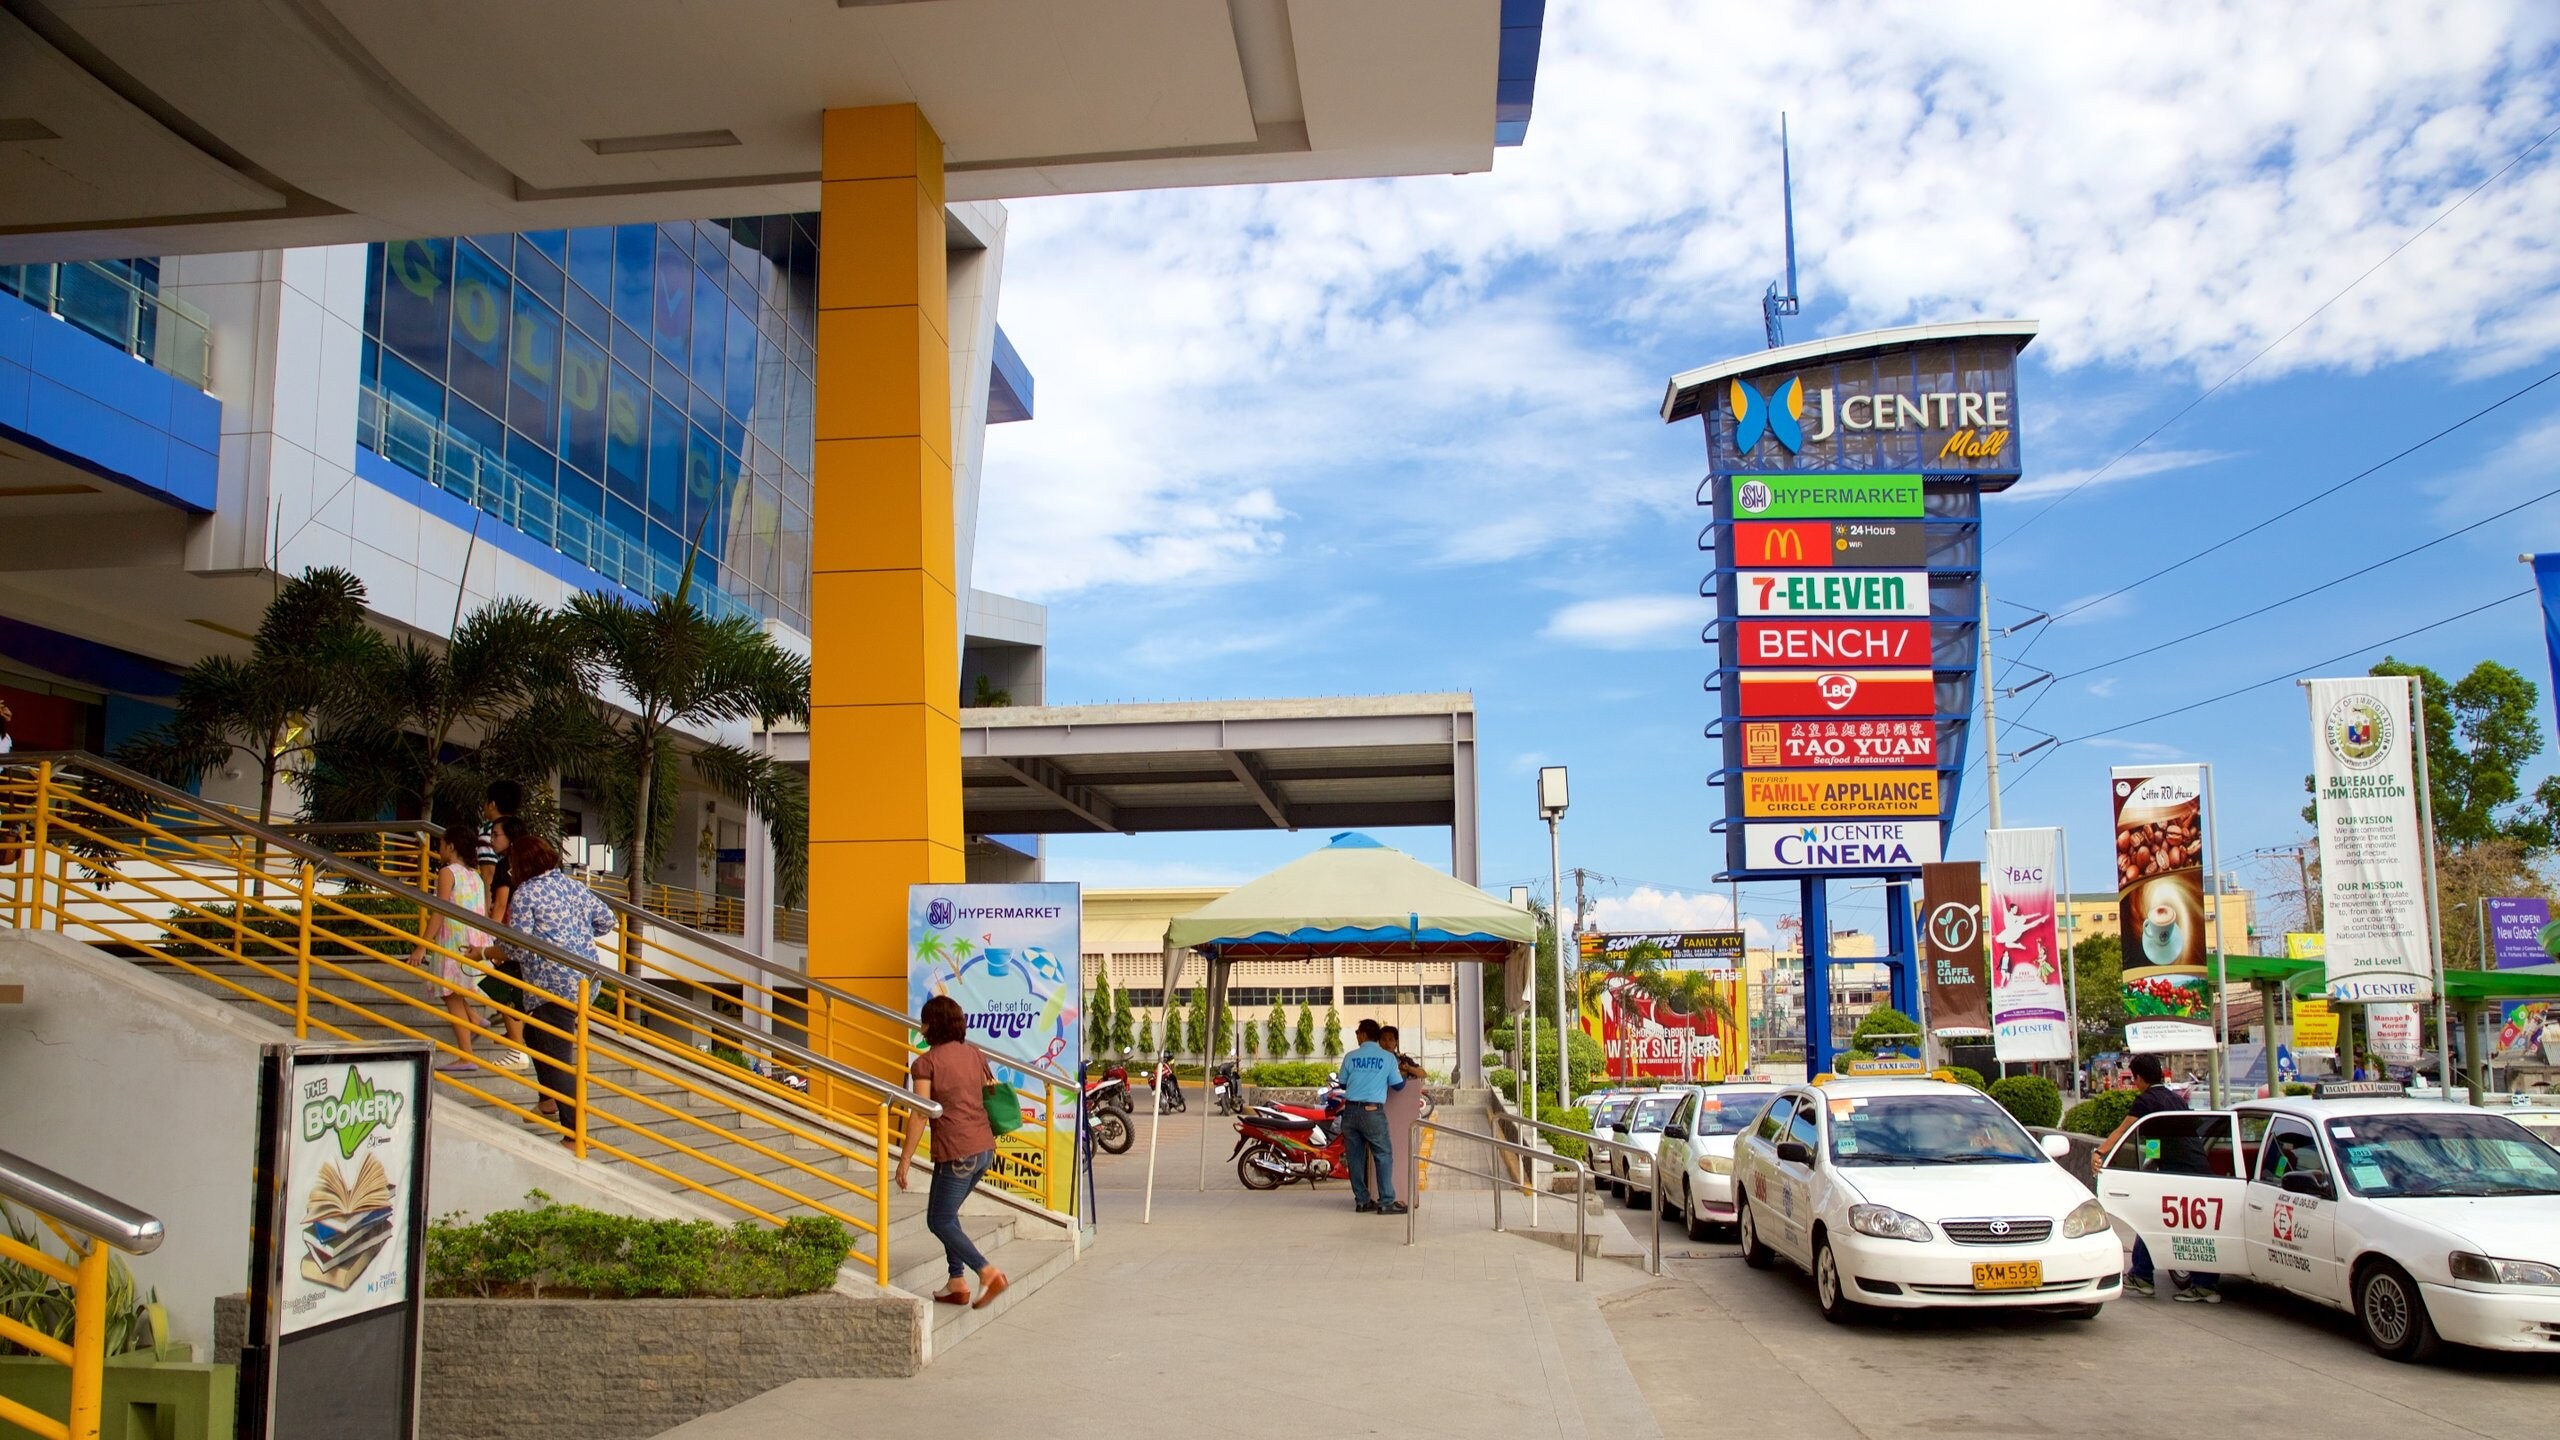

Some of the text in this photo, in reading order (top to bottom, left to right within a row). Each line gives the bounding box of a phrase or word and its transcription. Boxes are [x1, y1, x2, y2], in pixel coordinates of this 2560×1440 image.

[1939, 429, 2009, 458] Mall
[1773, 488, 1919, 504] HYPERMARKET
[1850, 525, 1896, 536] 24 Hours
[1822, 684, 1852, 698] LBC
[1785, 739, 1846, 756] TAO
[1853, 738, 1931, 756] YUAN
[1813, 755, 1904, 766] Seafood Restaurant
[2330, 774, 2394, 787] BUREAU OF
[1751, 782, 1932, 802] FAMILY APPLIANCE
[2322, 785, 2405, 800] IMMIGRATION
[1767, 802, 1918, 811] CIRCLE CORPORATION
[2337, 815, 2393, 825] OUR VISION
[1774, 835, 1913, 865] CINEMA
[2337, 881, 2403, 891] OUR MISSION
[2333, 892, 2341, 900] To
[2342, 892, 2367, 900] control
[2341, 900, 2379, 908] movement
[2388, 898, 2414, 907] persons
[958, 907, 1062, 919] HYPERMARKET
[2350, 907, 2368, 915] from
[2501, 914, 2541, 924] NOW OPEN!
[2336, 931, 2366, 940] National
[2497, 926, 2533, 940] New Globe
[1683, 938, 1718, 948] FAMILY
[1721, 936, 1741, 946] KTV
[1936, 959, 1951, 969] DE
[2354, 956, 2402, 967] 2nd Level
[1937, 967, 1969, 976] CAFFE
[1938, 975, 1975, 985] LUWAK
[988, 999, 1033, 1013] Get set for
[2373, 1014, 2402, 1023] Manage
[963, 1011, 1041, 1039] ummer
[2381, 1022, 2408, 1030] Korean
[2377, 1030, 2412, 1038] Designers
[1607, 1039, 1722, 1059] WEAR SNEAKERS
[1352, 1057, 1384, 1070] TRAFFIC
[1878, 1062, 1898, 1070] TAXI
[304, 1078, 328, 1099] THE
[2324, 1084, 2348, 1094] VACANT
[2351, 1083, 2376, 1093] TAXI
[304, 1093, 403, 1141] BOOKERY
[1011, 1152, 1042, 1177] TAG
[2162, 1196, 2223, 1231] 5167
[2279, 1213, 2287, 1231] E
[1976, 1265, 2038, 1281] GXM 599
